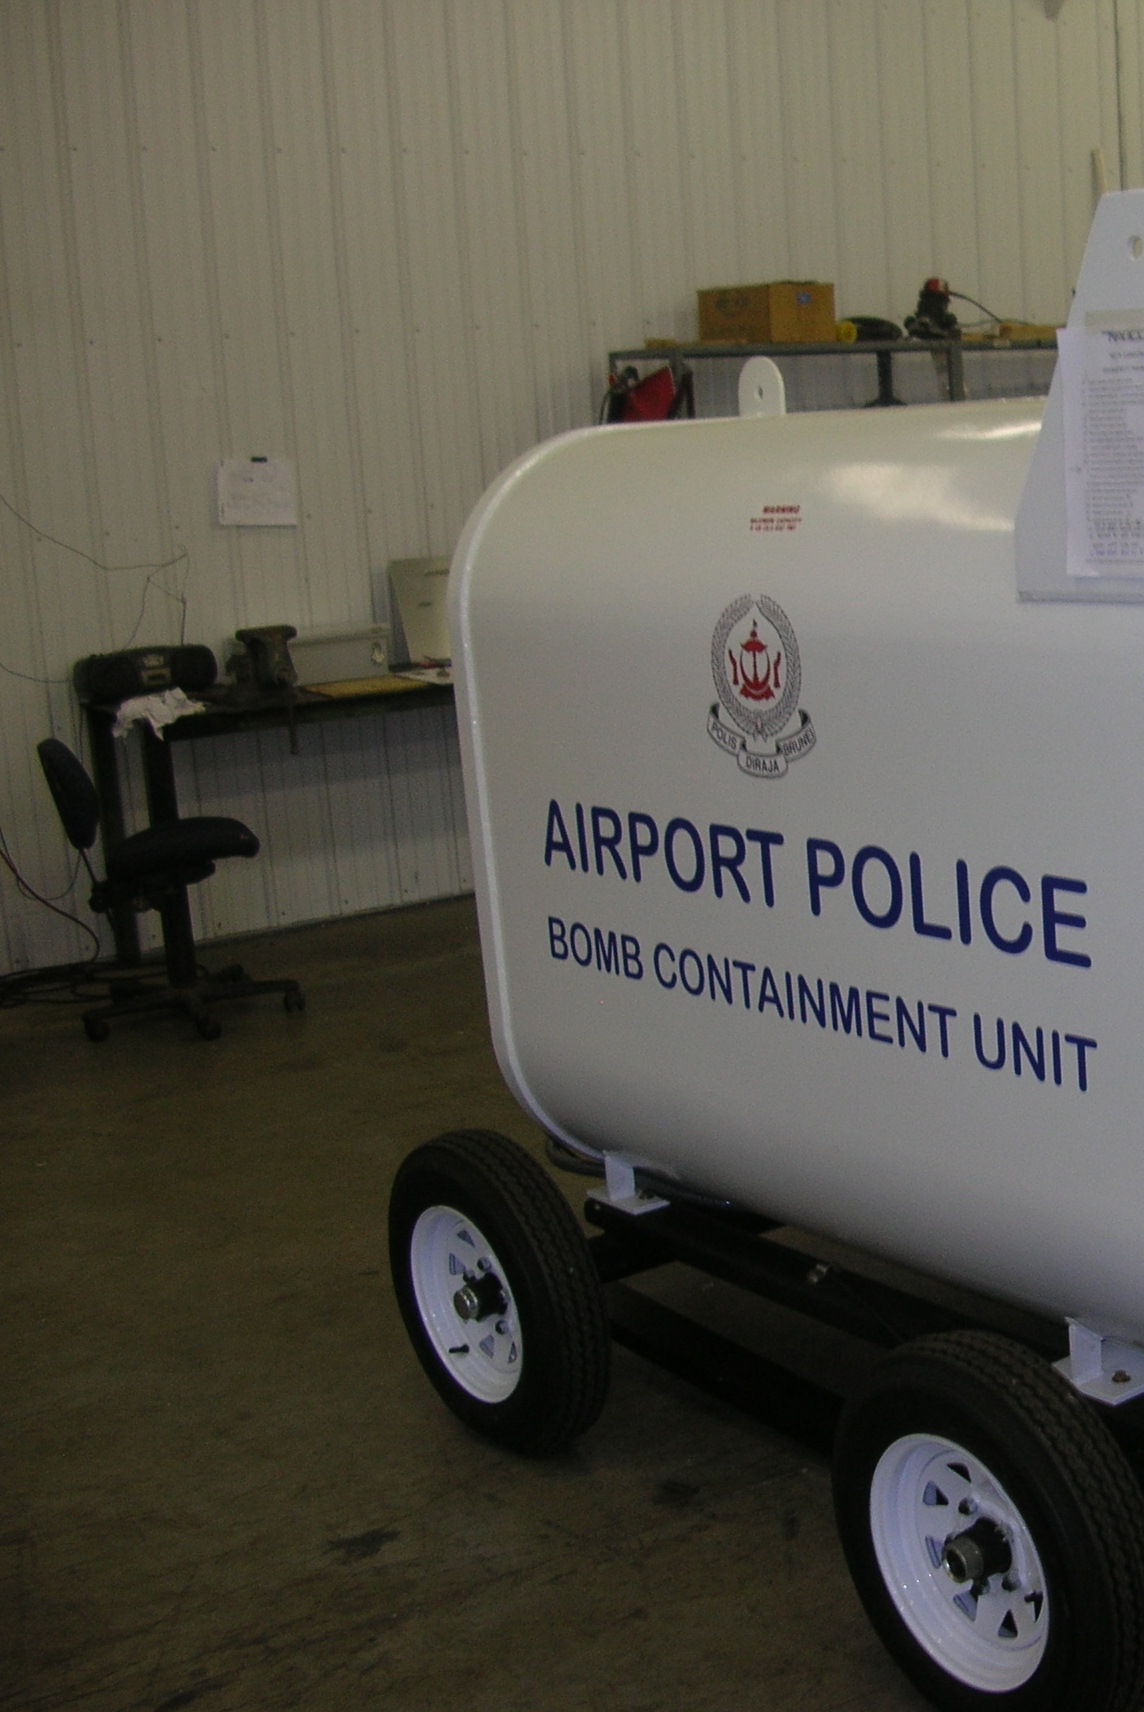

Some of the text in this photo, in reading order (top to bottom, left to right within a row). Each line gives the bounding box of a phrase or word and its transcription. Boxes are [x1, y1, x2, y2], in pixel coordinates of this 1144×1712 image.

[711, 724, 738, 751] POLIS
[745, 755, 780, 773] DIRAJA
[544, 799, 1092, 969] AIRPORT POLICE
[548, 916, 1097, 1092] BOMB CONTAINMENT UNIT
